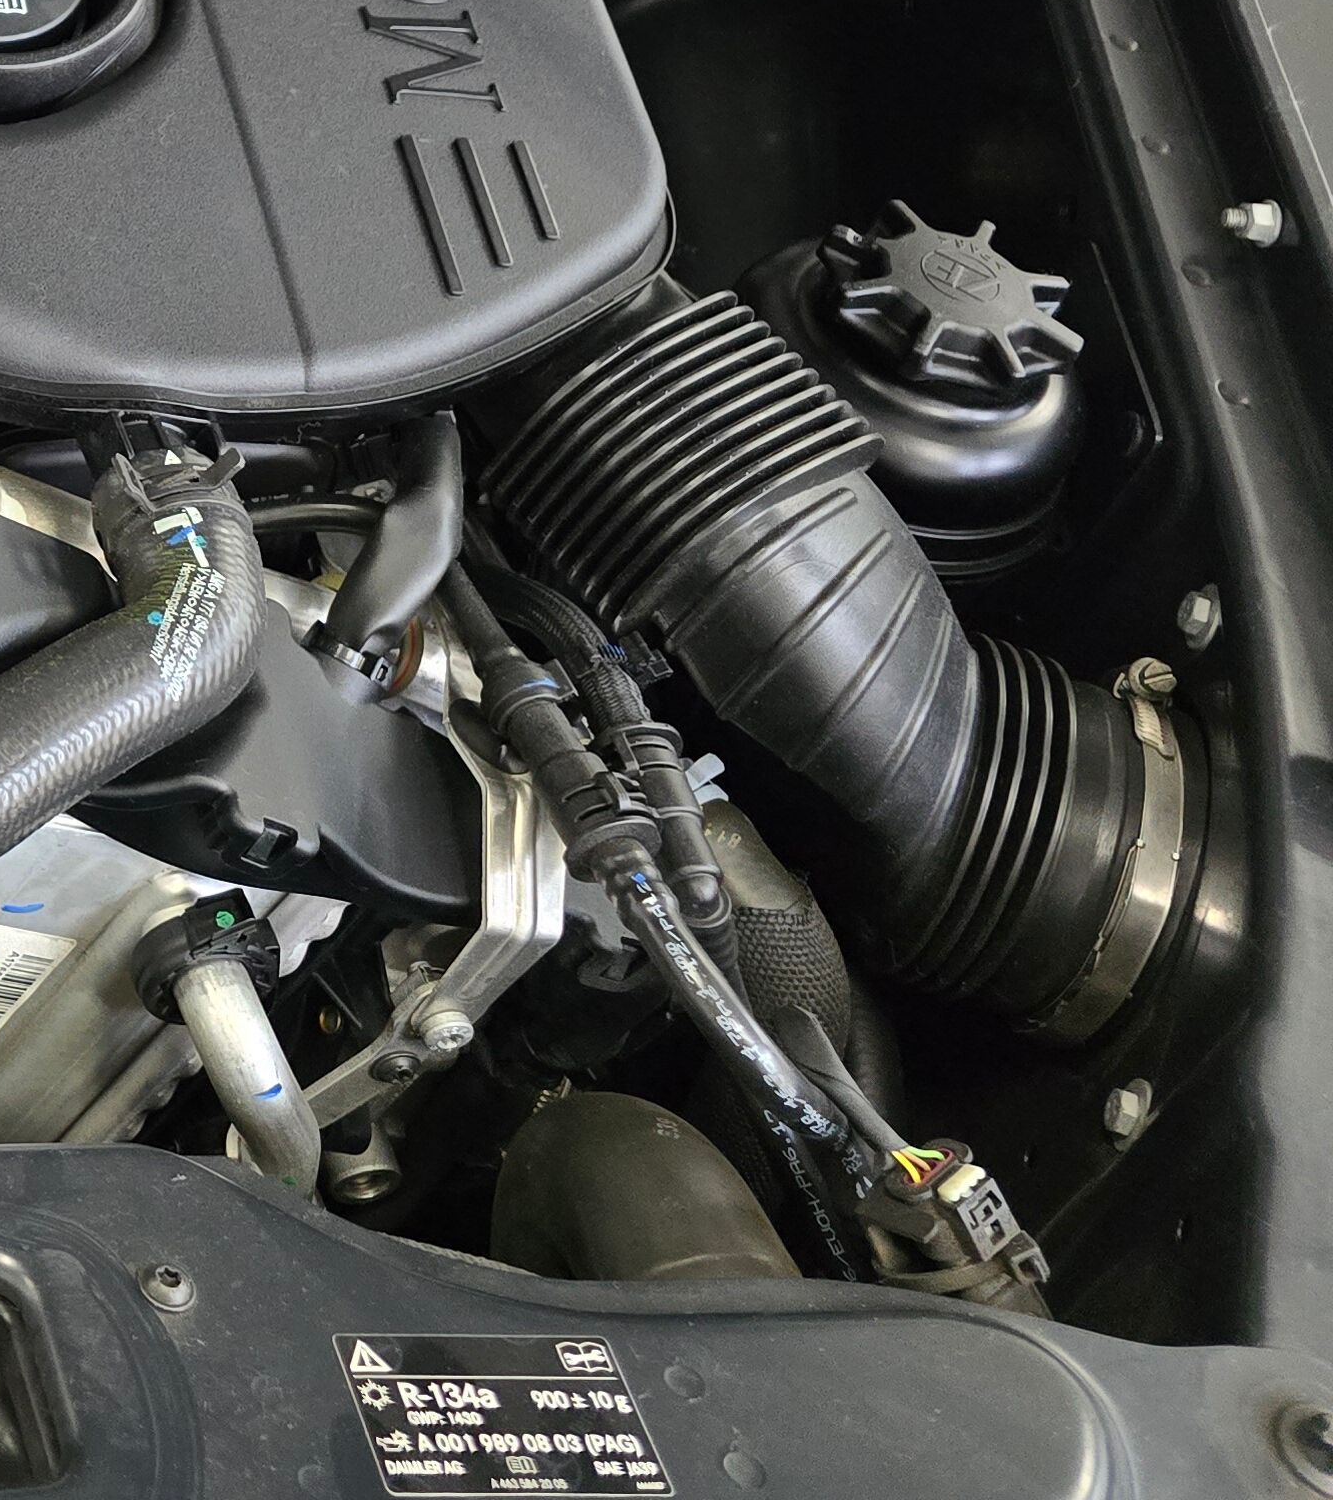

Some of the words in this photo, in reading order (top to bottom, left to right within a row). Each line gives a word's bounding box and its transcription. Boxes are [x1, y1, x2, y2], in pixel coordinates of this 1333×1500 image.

[397, 1381, 501, 1409] R-134a
[531, 1390, 569, 1409] 900
[589, 1391, 614, 1409] 10
[615, 1395, 633, 1414] g
[417, 1433, 435, 1452] A
[436, 1433, 477, 1452] 001
[480, 1434, 518, 1452] 989
[523, 1434, 550, 1453] 08
[554, 1435, 583, 1453] 03
[585, 1433, 643, 1456] (PAG)
[385, 1460, 443, 1474] DAIMLER
[593, 1461, 623, 1474] SAE
